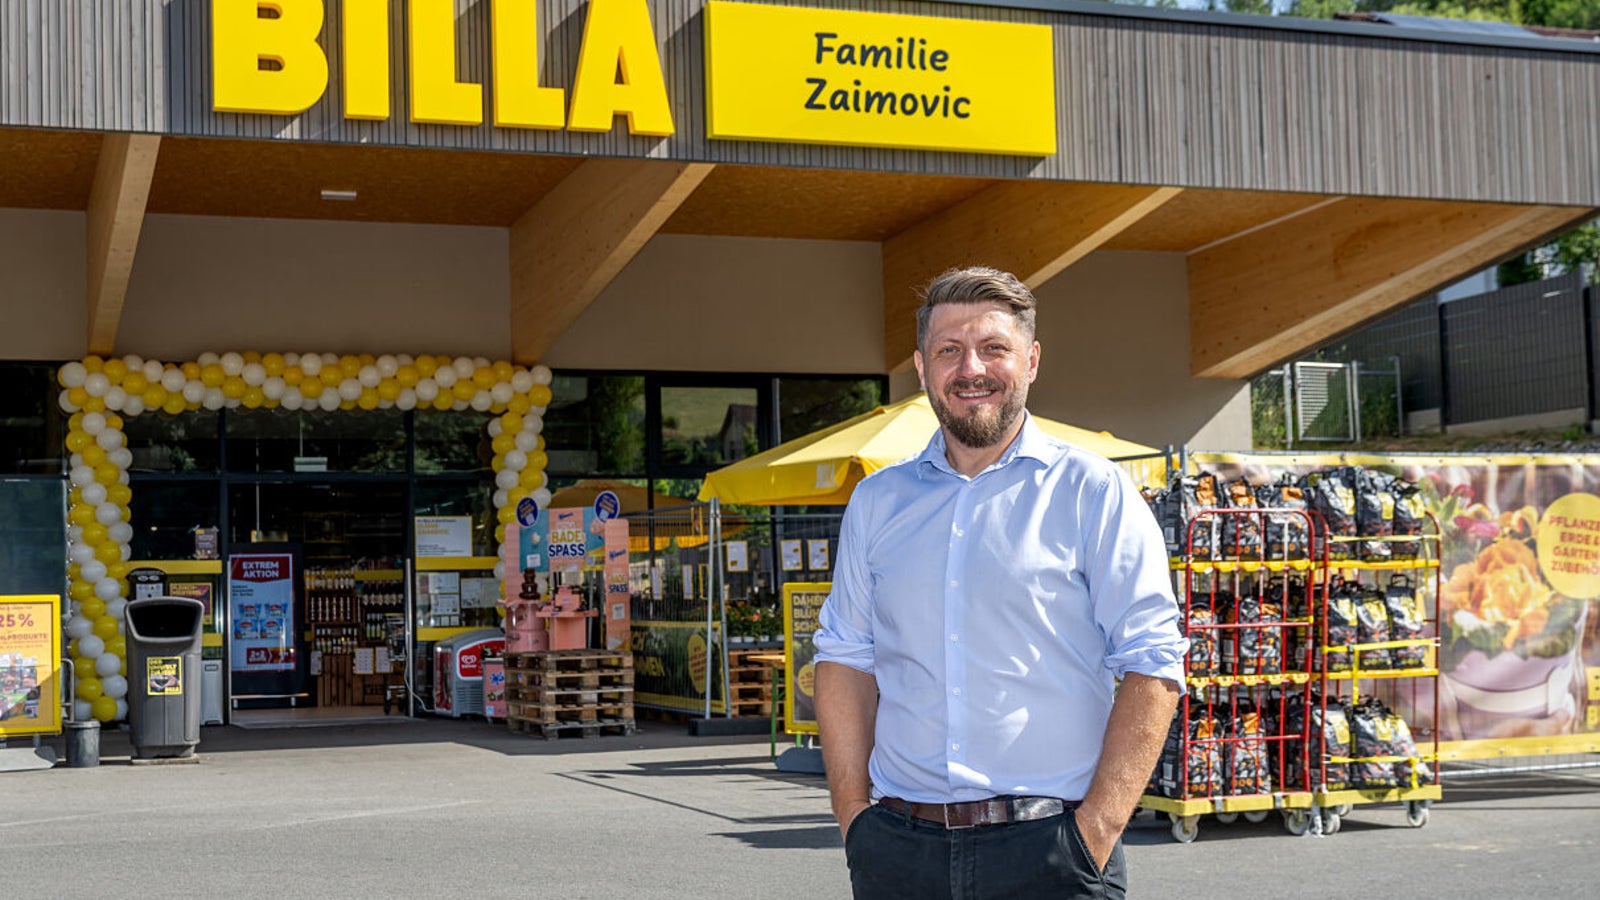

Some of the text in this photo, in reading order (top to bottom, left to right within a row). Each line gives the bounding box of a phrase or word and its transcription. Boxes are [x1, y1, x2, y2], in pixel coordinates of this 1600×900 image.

[815, 32, 949, 71] Familie
[213, 0, 675, 136] BILLA
[804, 77, 971, 118] Zaimovic
[1560, 531, 1591, 545] ERDE
[548, 543, 585, 557] SPASS
[242, 561, 279, 569] EXTREM
[243, 570, 279, 578] AKTION
